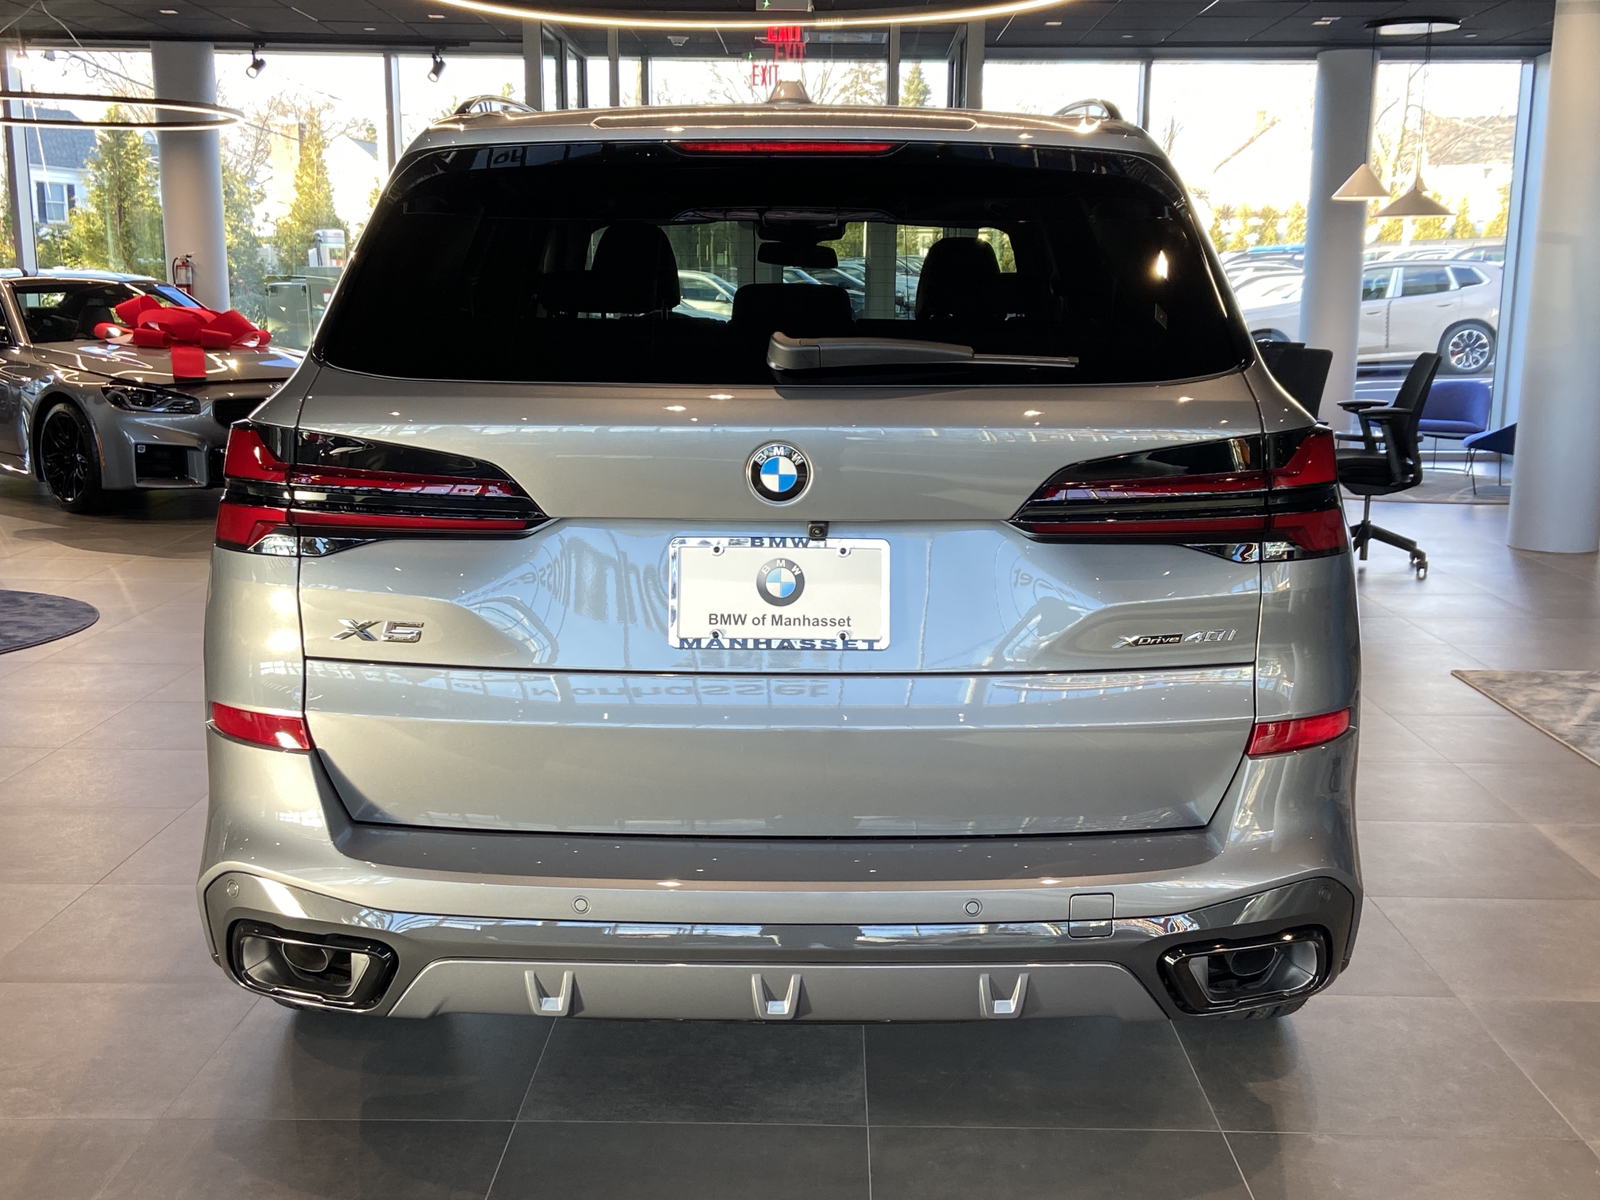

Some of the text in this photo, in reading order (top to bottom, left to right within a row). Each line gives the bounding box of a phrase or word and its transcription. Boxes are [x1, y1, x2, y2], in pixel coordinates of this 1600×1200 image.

[752, 65, 779, 86] EXIT
[755, 446, 804, 466] BMW
[750, 537, 811, 548] BMW
[761, 559, 803, 576] BMW
[708, 613, 852, 628] BMW of Manhasset
[329, 618, 424, 643] X5
[678, 637, 876, 651] MANHASSET
